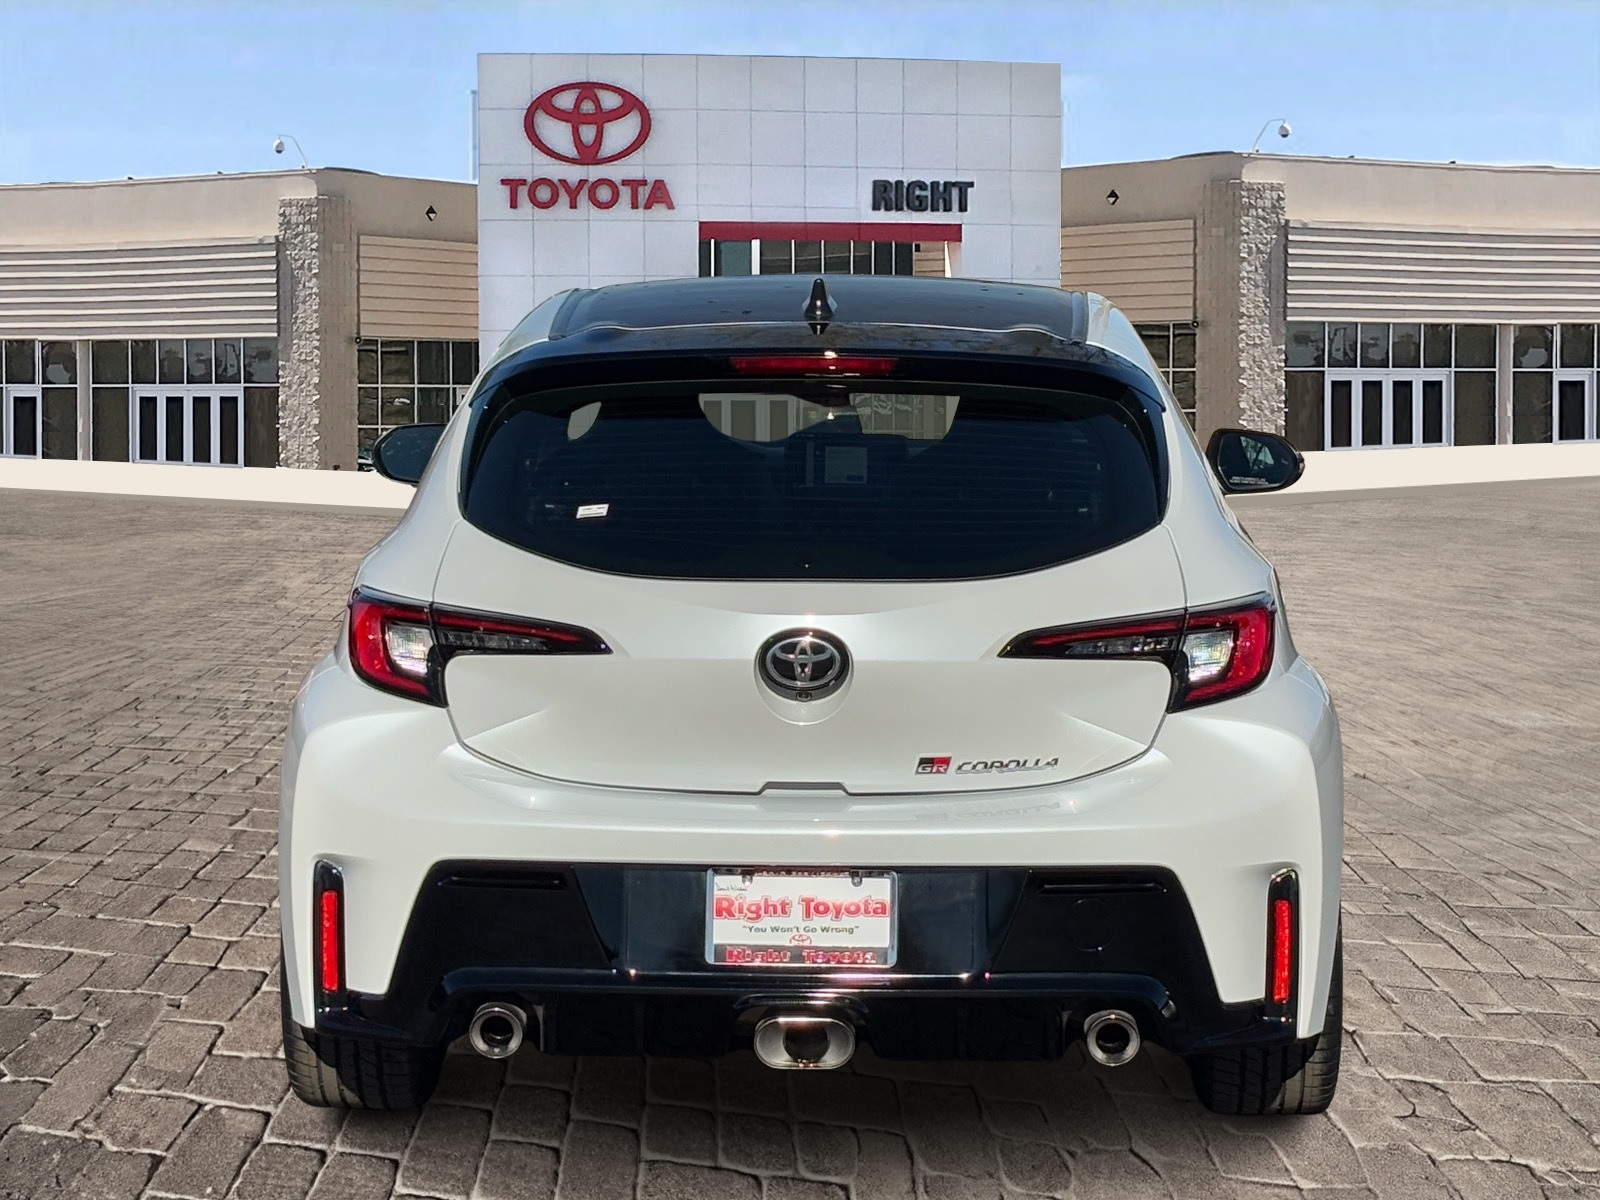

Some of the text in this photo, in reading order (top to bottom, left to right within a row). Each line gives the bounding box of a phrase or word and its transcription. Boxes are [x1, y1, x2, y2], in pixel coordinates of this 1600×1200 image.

[500, 178, 675, 210] TOYOTA
[872, 179, 975, 212] RIGHT
[917, 757, 1061, 775] GR COROLLA
[713, 893, 889, 923] Right Toyota
[770, 925, 800, 933] Won't
[803, 925, 818, 933] Go
[726, 946, 877, 964] Right Toyota
